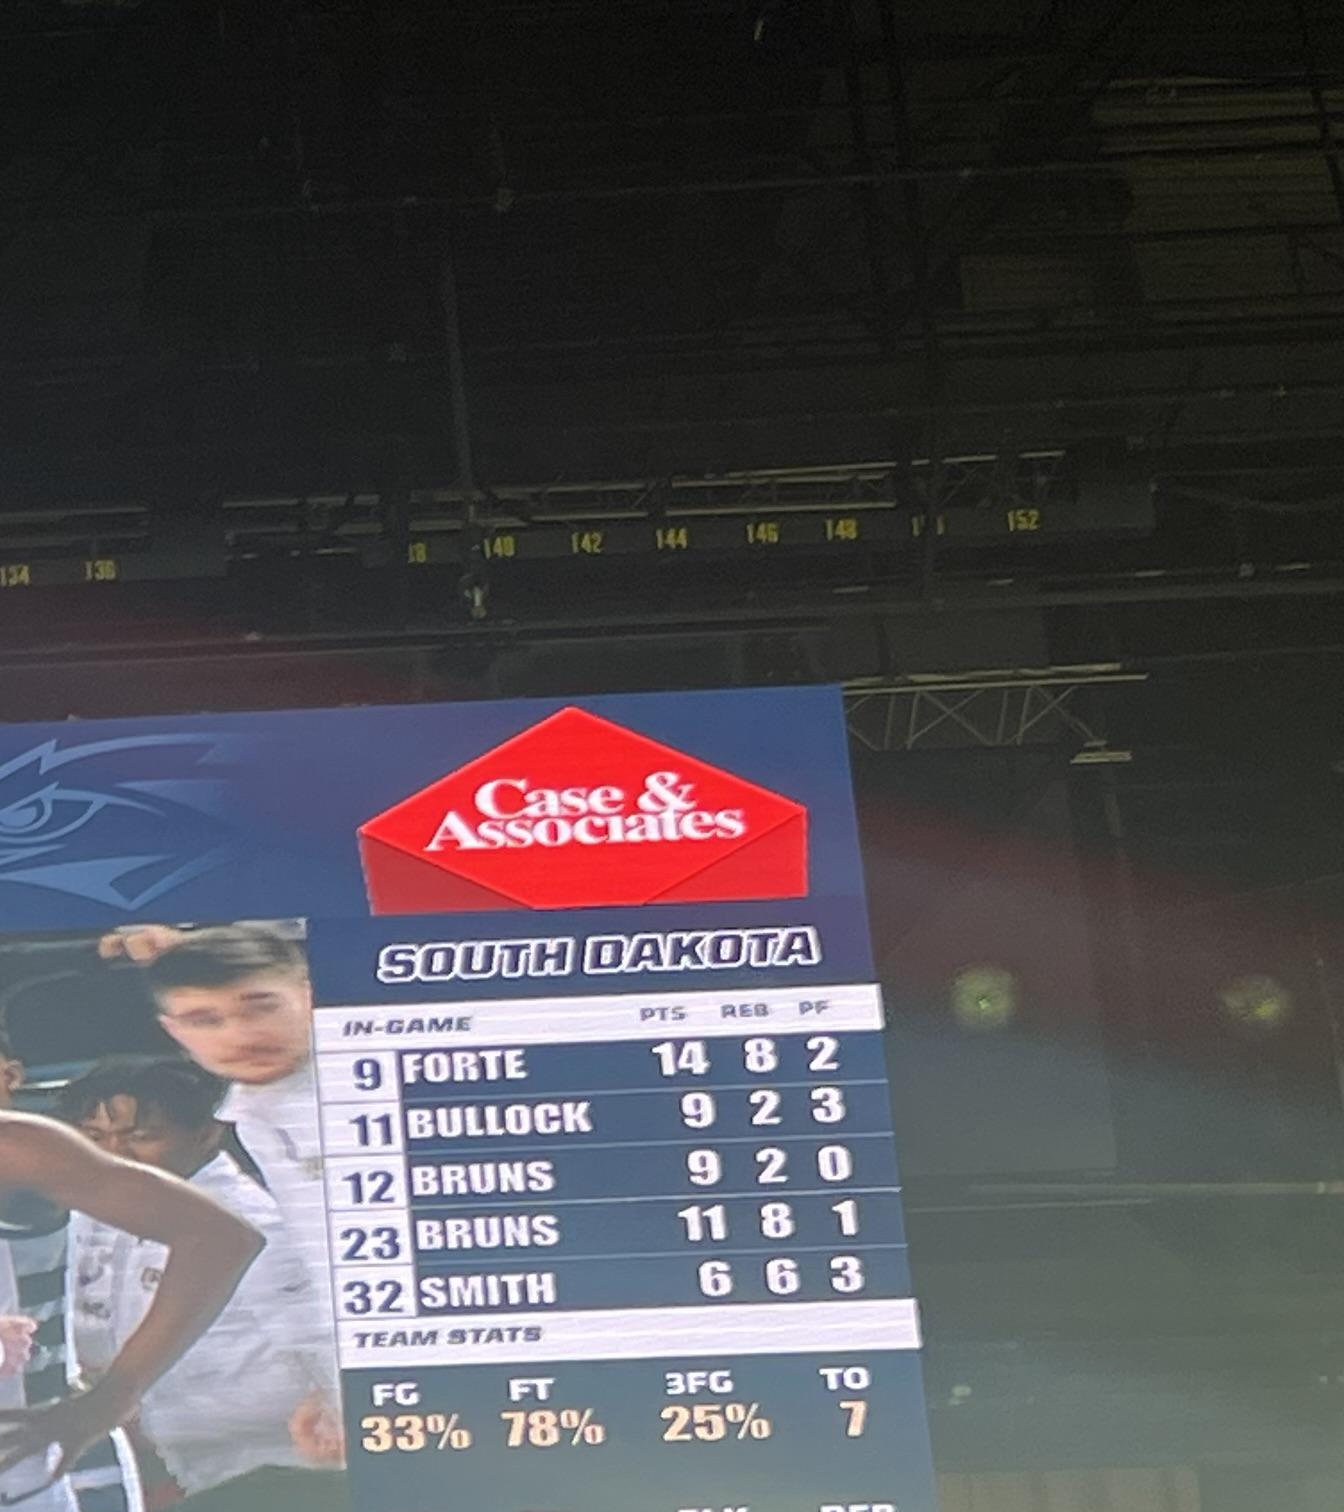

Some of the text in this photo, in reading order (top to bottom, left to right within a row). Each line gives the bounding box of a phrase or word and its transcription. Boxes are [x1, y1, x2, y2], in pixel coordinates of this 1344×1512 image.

[656, 528, 688, 550] 144
[0, 565, 30, 587] 134
[474, 771, 697, 820] Case &
[425, 806, 746, 851] Associates
[377, 926, 820, 983] SOUTH DAKOTA
[344, 1001, 830, 1036] IN-GAME PTS REB PF
[354, 1037, 839, 1091] 9 FORTE 14 8 2
[349, 1087, 844, 1146] 11 BULLOCK 9 2 3
[342, 1146, 852, 1204] 12 BRUNS 9 2 0
[341, 1200, 858, 1260] 23 BRUNS 11 8 1
[344, 1256, 864, 1314] 32 SMITH 6 6 3
[355, 1327, 541, 1348] TEAM STATS
[373, 1367, 870, 1406] FG FT 3FG TO
[361, 1400, 868, 1451] 33% 78% 25% 7
